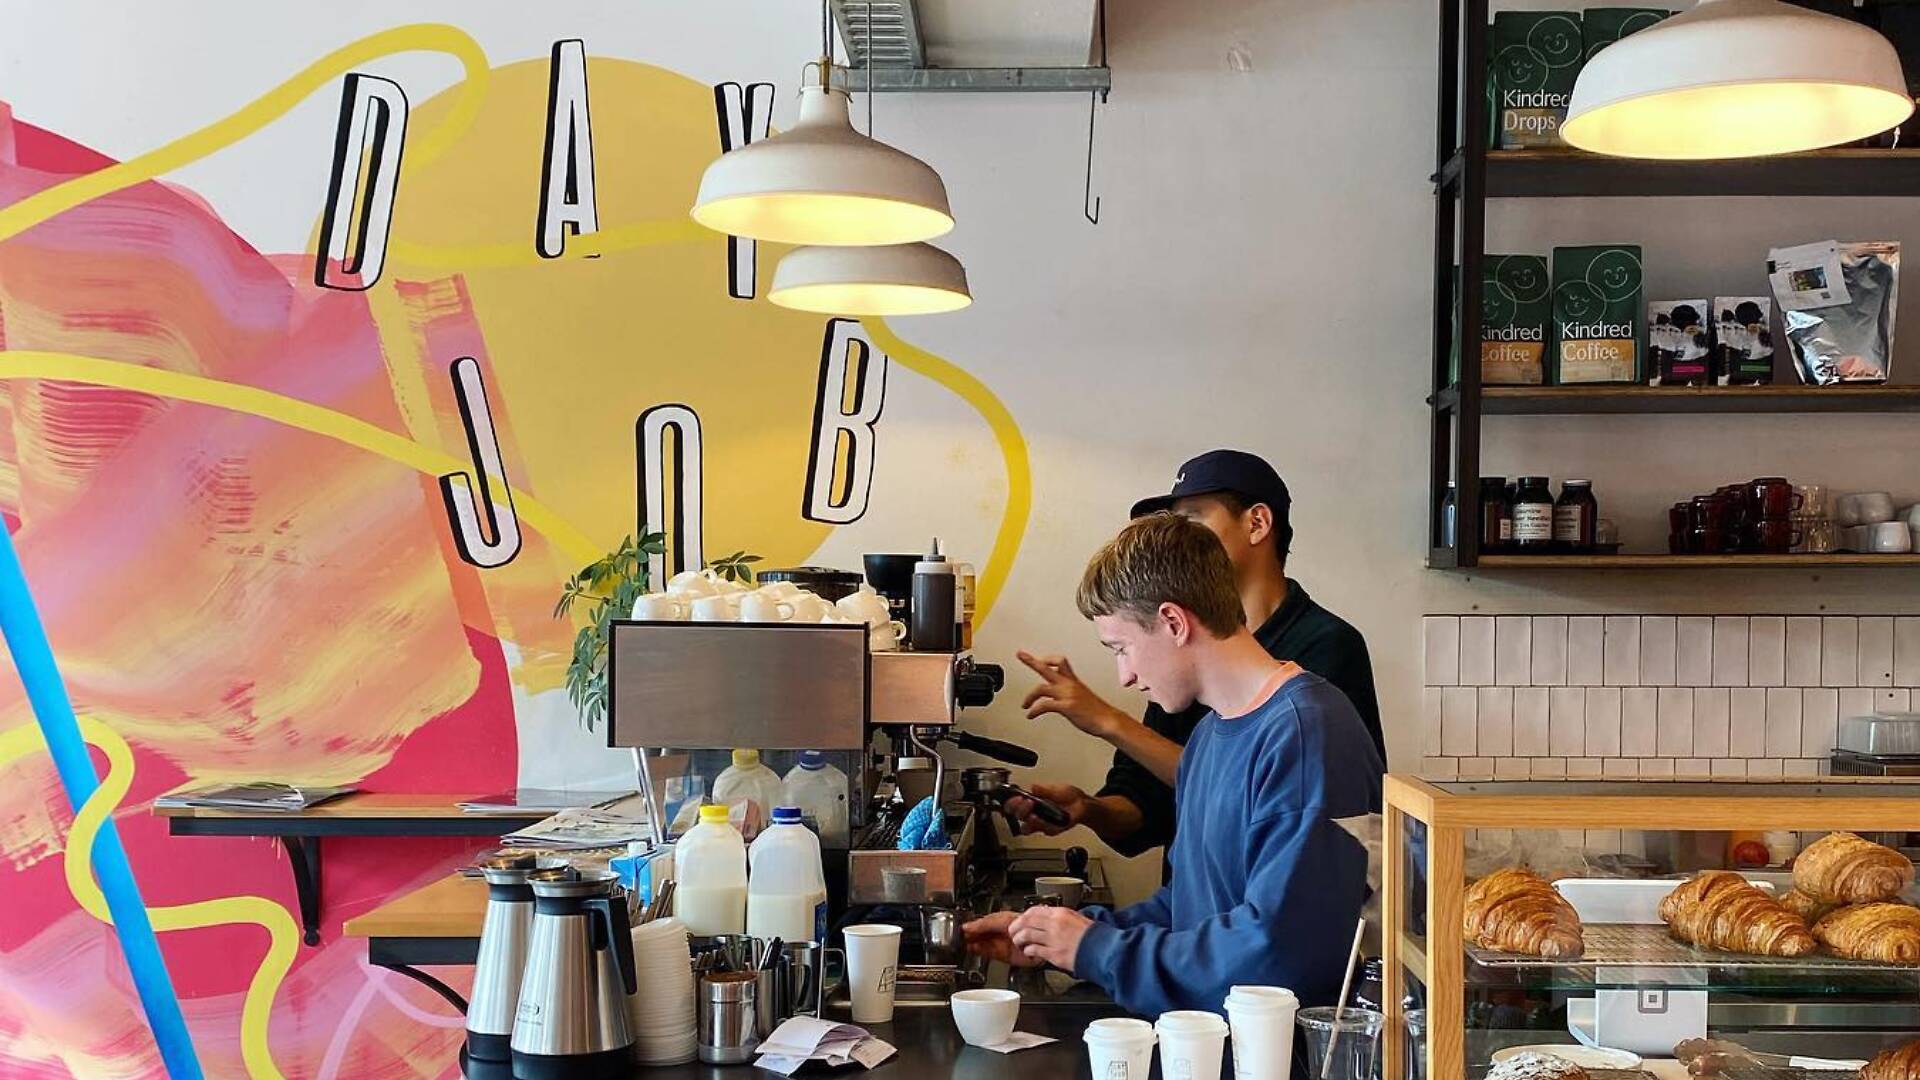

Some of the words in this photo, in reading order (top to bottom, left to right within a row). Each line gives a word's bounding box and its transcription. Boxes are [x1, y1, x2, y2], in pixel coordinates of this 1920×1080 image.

[1503, 110, 1556, 135] Drops
[315, 38, 776, 300] DAY
[1562, 320, 1632, 340] Kindred
[1564, 342, 1619, 361] Coffee
[439, 317, 888, 592] JOB
